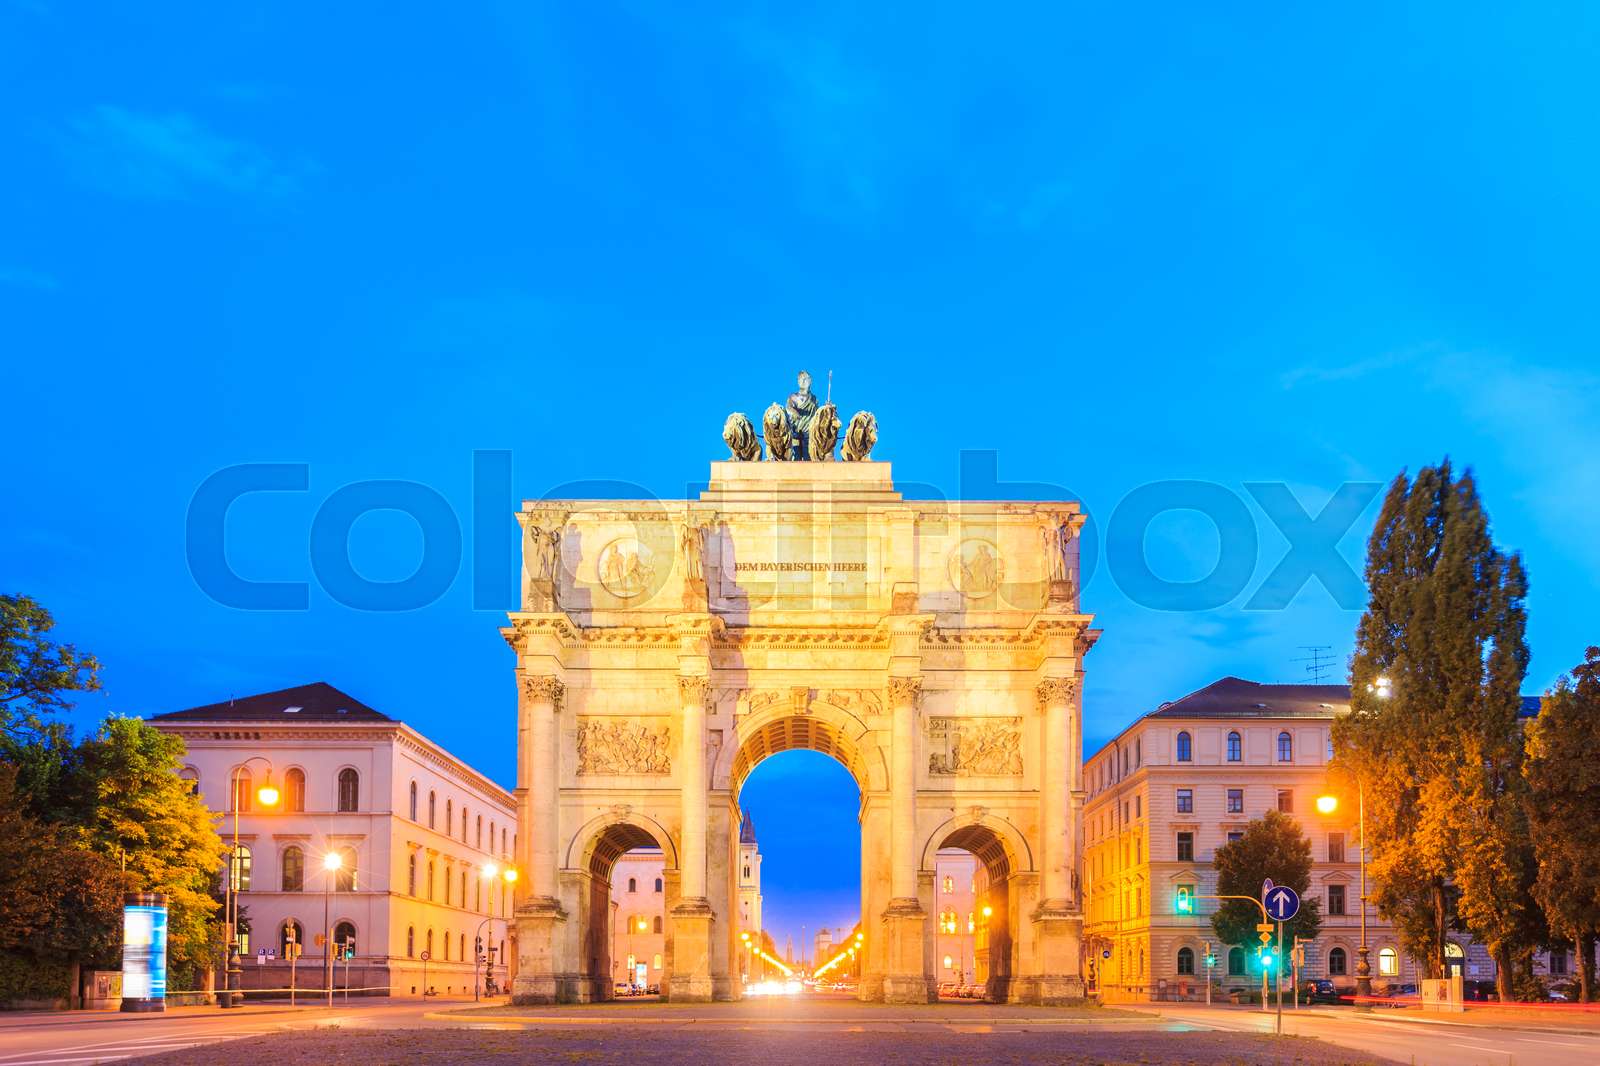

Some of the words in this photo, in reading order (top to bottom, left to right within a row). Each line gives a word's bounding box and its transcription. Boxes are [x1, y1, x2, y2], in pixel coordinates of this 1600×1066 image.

[735, 562, 758, 572] DEM
[760, 562, 831, 572] BAYERISCHEN
[833, 562, 868, 572] HEERE
